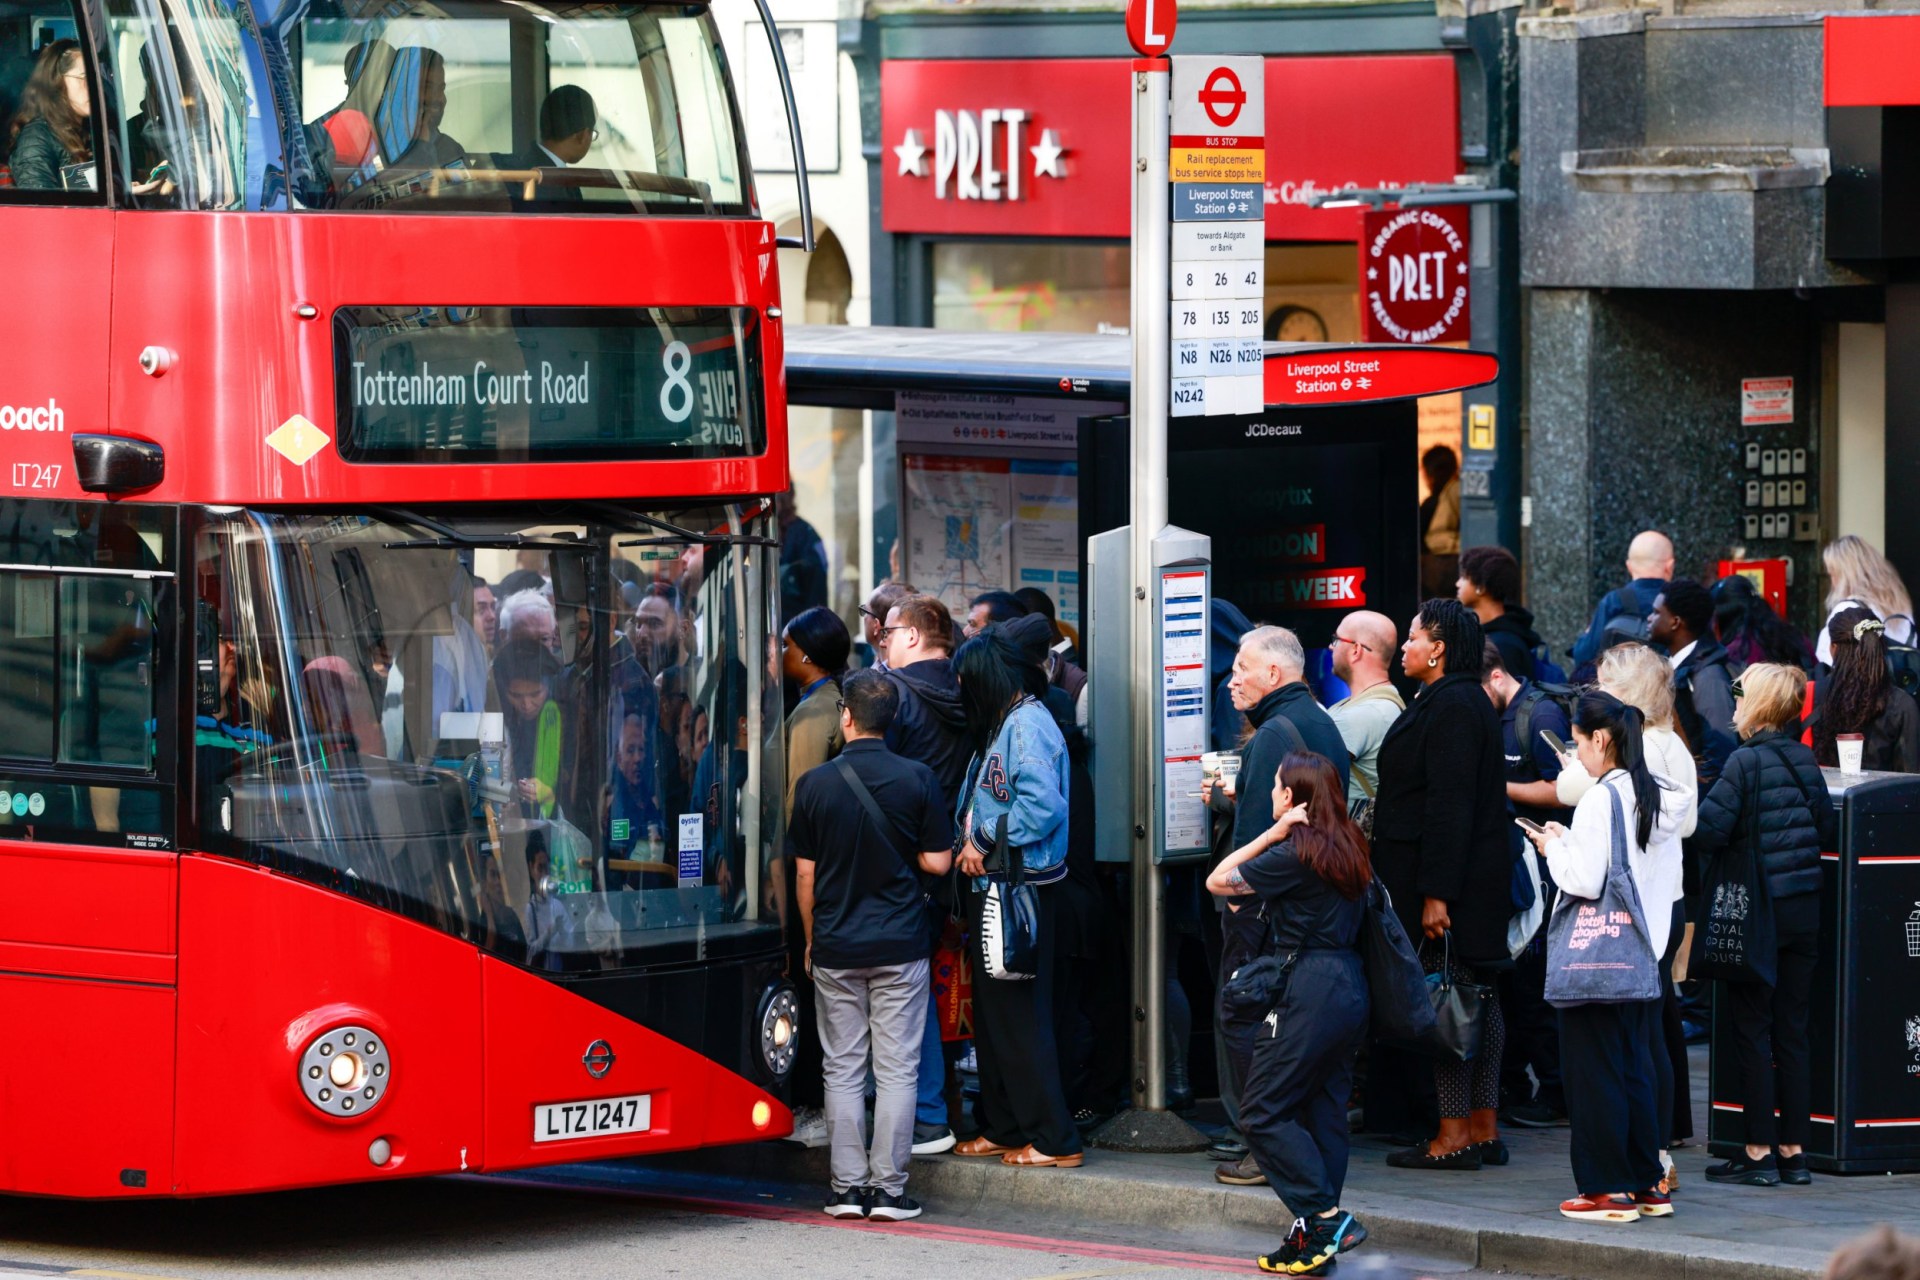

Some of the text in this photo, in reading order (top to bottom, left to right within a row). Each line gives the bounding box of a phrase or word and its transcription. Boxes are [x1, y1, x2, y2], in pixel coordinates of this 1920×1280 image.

[1144, 0, 1166, 45] L
[1206, 137, 1238, 146] BUS STOP
[935, 108, 1026, 200] PRET
[1187, 154, 1253, 166] Rail replacement
[1175, 168, 1262, 180] bus service stops here
[1189, 189, 1254, 202] Liverpool Street
[1194, 203, 1225, 214] Station
[1197, 231, 1246, 241] towards Aldgate
[1370, 210, 1463, 257] ORGANIC COFFEE
[1218, 243, 1232, 252] Bank
[1186, 271, 1256, 287] 8 26 42
[1389, 251, 1447, 302] PRET
[1183, 310, 1259, 326] 78 135 205
[1369, 286, 1467, 343] FRESHLY MADE FOOD
[1181, 349, 1262, 364] N8 N26 N205
[1287, 360, 1380, 377] Liverpool Street
[353, 360, 589, 407] Tottenham Court Road
[660, 340, 694, 424] 8
[1295, 380, 1337, 393] Station
[1174, 389, 1204, 403] N242
[0, 398, 64, 432] oach
[960, 411, 982, 421] Market
[1245, 424, 1302, 437] JCDecaux
[1473, 410, 1491, 443] H
[1007, 430, 1038, 442] Liverpool
[1040, 431, 1060, 441] Street
[1460, 471, 1488, 495] 192
[1290, 575, 1357, 602] WEEK
[681, 816, 700, 826] oyster
[1578, 905, 1597, 916] the
[1575, 911, 1632, 928] Nottig Hill
[1572, 925, 1620, 940] shopping
[1709, 921, 1743, 936] ROYAL
[982, 895, 1000, 978] lululemo
[1705, 936, 1744, 951] OPERA
[1704, 950, 1742, 966] HOUSE
[547, 1100, 638, 1135] LTZ 1247
